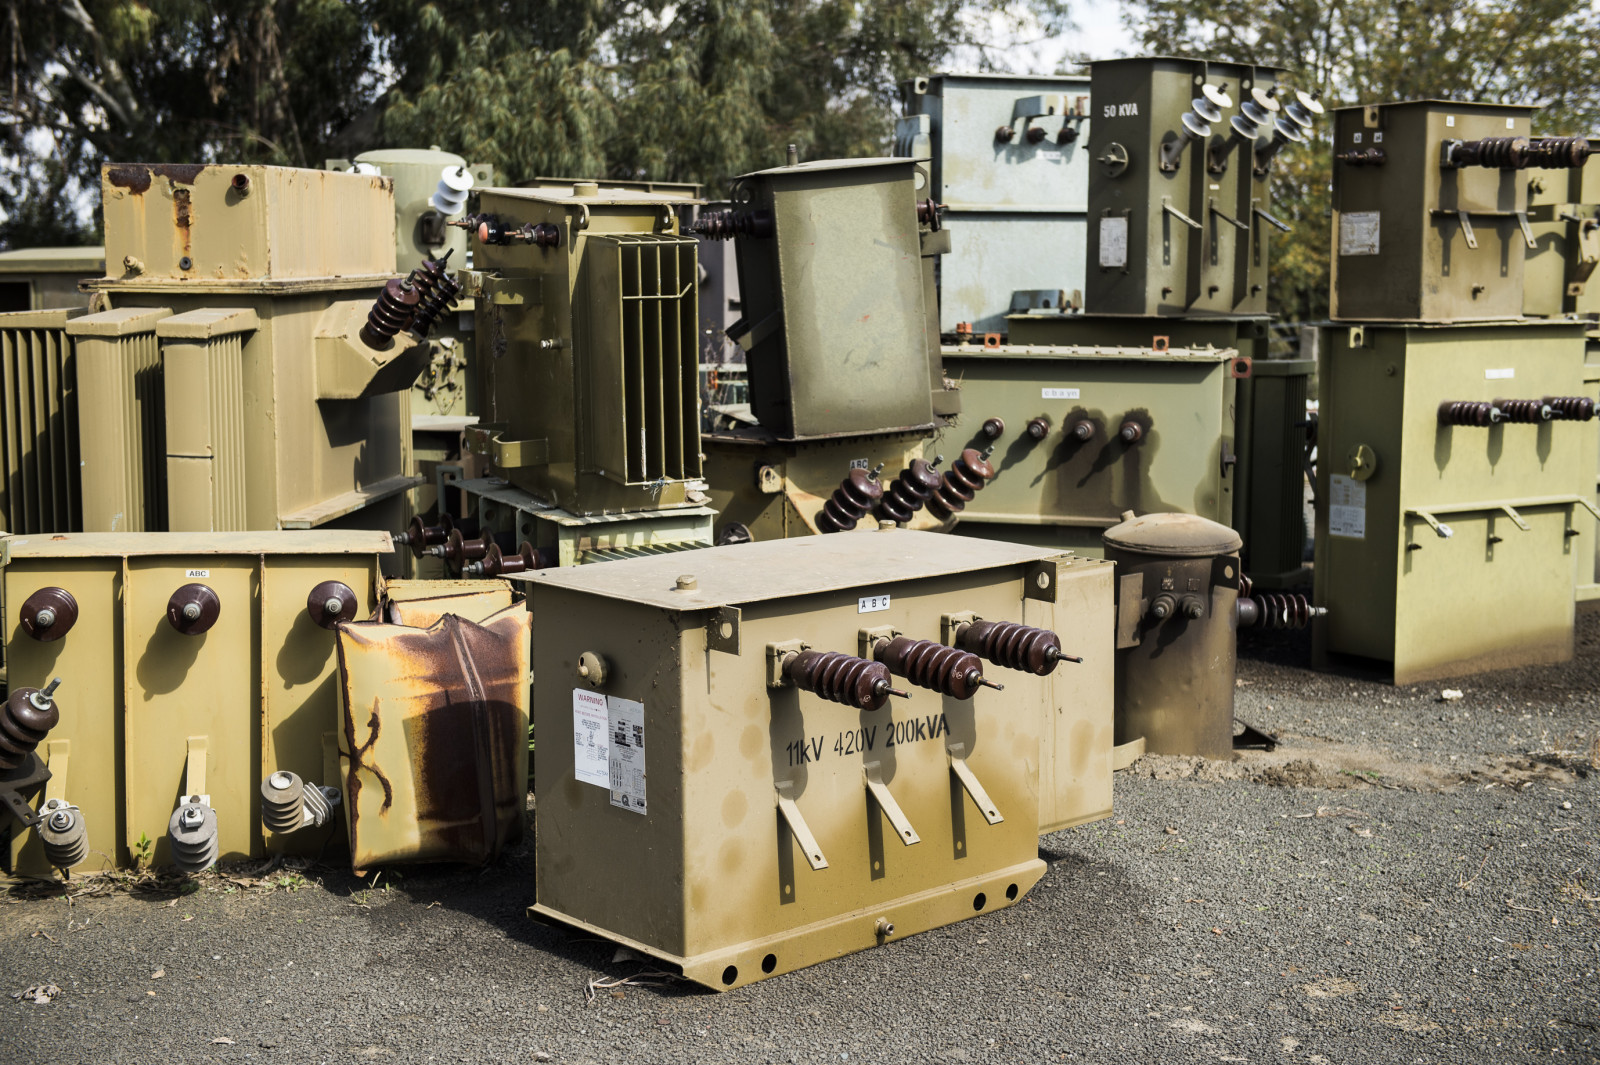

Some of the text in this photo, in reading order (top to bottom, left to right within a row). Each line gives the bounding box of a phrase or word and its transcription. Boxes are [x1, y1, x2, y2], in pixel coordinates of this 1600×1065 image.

[1103, 102, 1139, 118] 50 KVA
[577, 693, 604, 706] WARNING
[786, 712, 951, 767] 11kV 420V 200kVA
